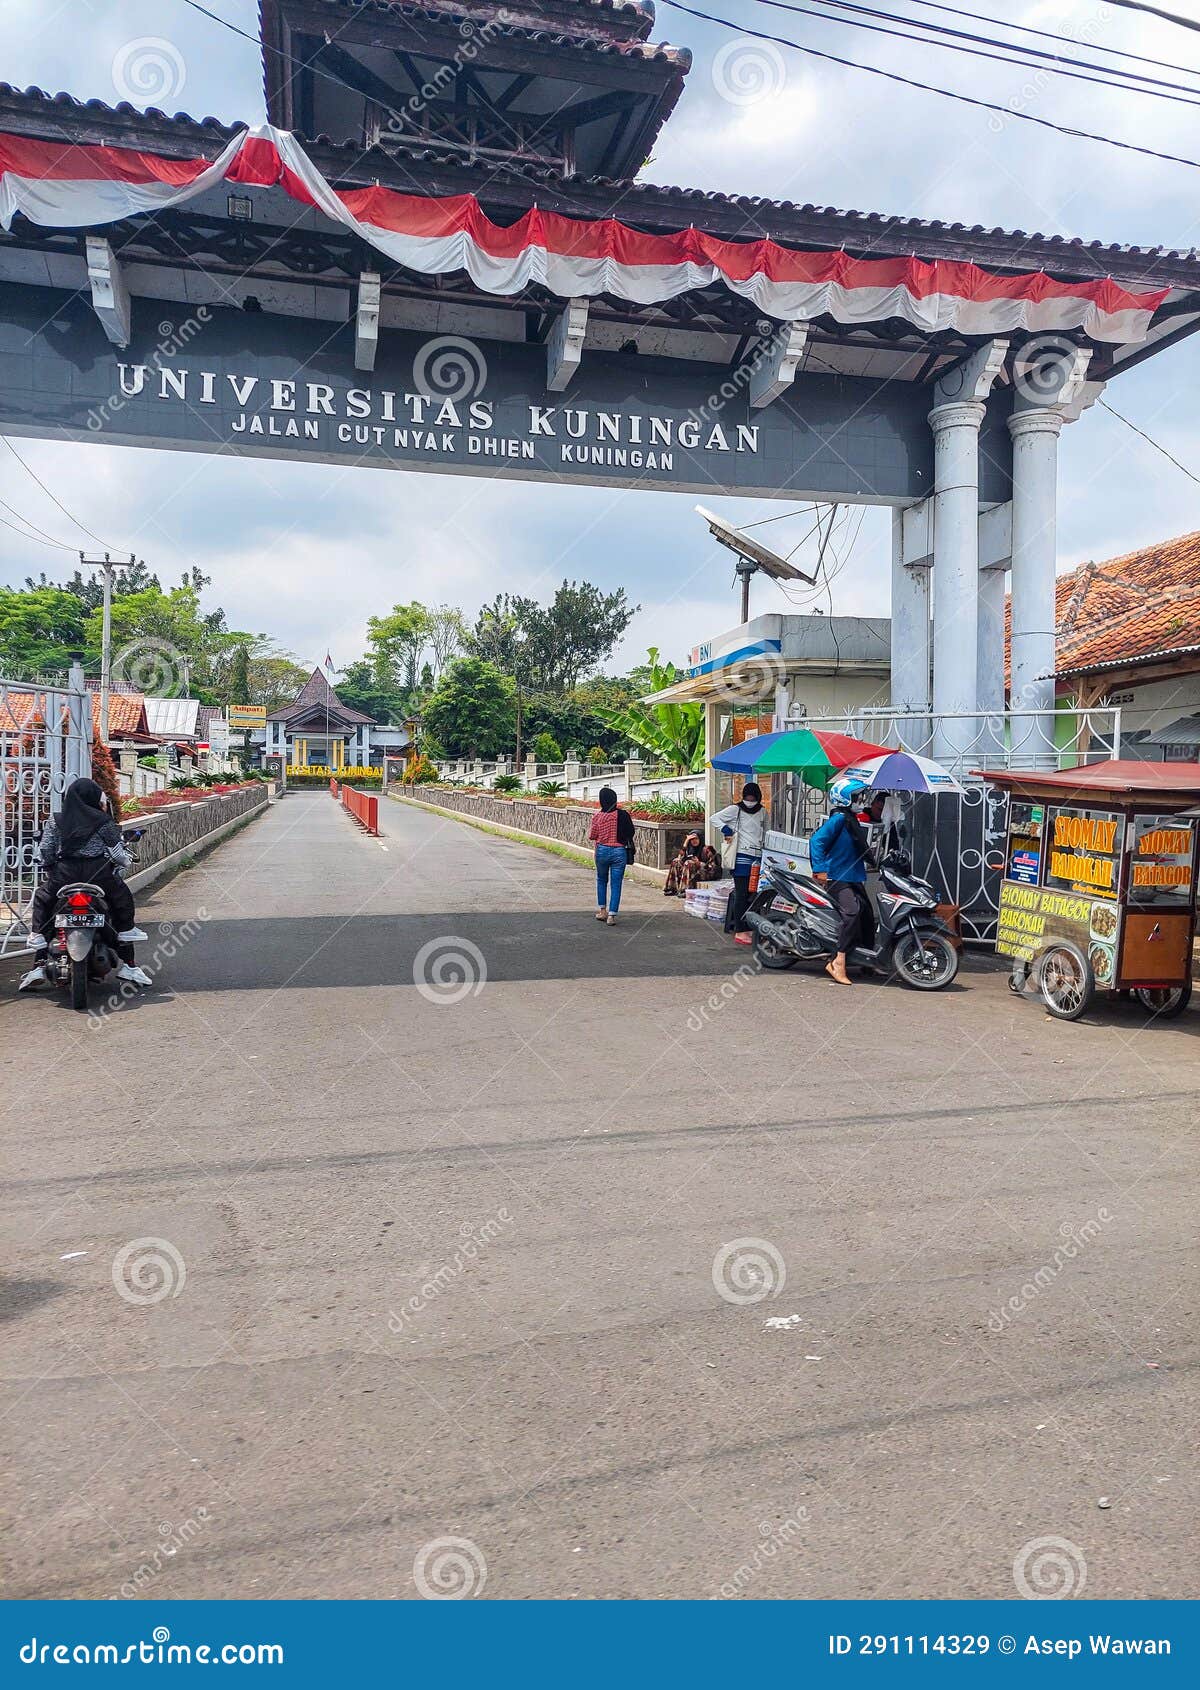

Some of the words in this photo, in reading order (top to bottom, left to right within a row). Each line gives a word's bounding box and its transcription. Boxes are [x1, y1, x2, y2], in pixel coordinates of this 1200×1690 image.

[117, 363, 494, 430] UNIVERSITAS
[528, 406, 760, 453] KUNINGAN
[232, 413, 319, 439] JALAN
[338, 423, 386, 446] CUT
[394, 430, 456, 452] NYAK
[468, 436, 535, 459] DHIEN
[561, 444, 673, 471] KUNINGAN
[1053, 815, 1118, 854] SIOMAY
[1138, 830, 1193, 855] SIOMAY
[1050, 851, 1114, 888] BAROKAH
[1132, 865, 1192, 887] BATAGOR
[999, 907, 1047, 935] BAROKAH
[1001, 885, 1040, 910] SIOMAY
[1040, 893, 1092, 921] BATAGOR
